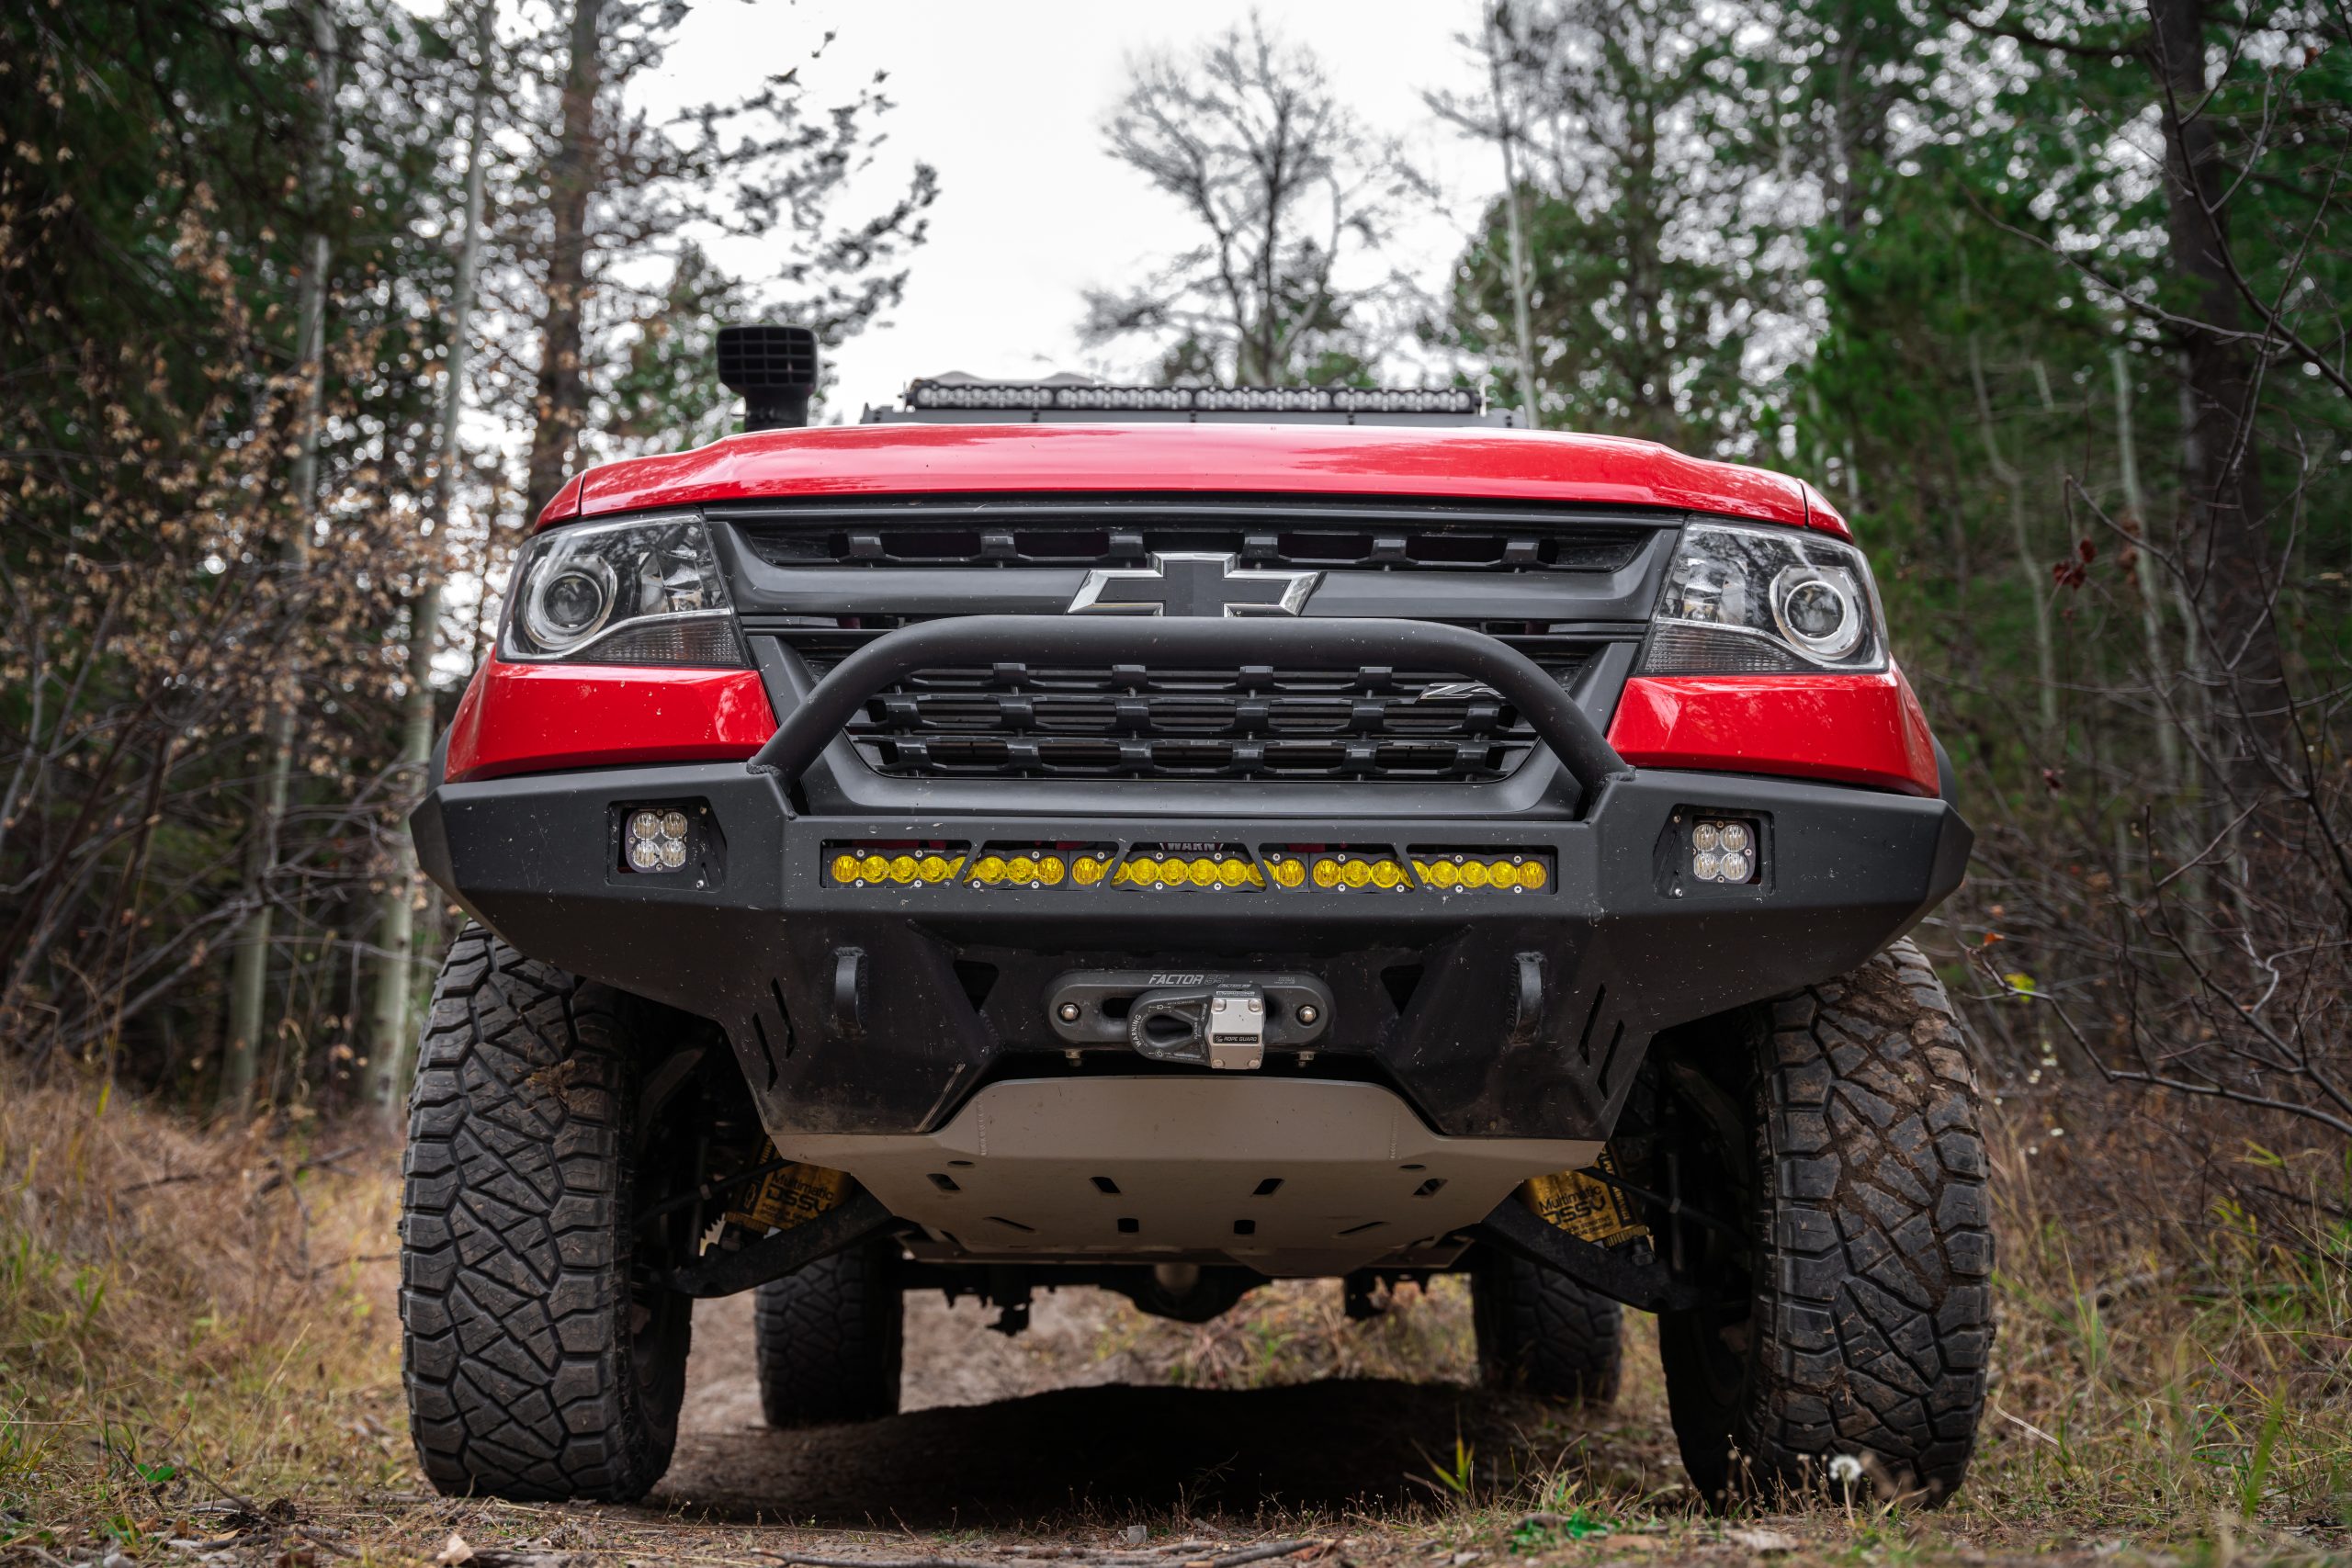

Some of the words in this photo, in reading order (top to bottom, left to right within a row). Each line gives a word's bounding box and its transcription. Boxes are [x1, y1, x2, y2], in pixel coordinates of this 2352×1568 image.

[1168, 842, 1216, 851] WARN
[1148, 974, 1204, 985] FACTOR
[1204, 974, 1227, 985] 55
[1131, 1014, 1142, 1048] WARNING
[773, 1173, 834, 1201] Multimatic
[1538, 1185, 1602, 1213] Multimatic
